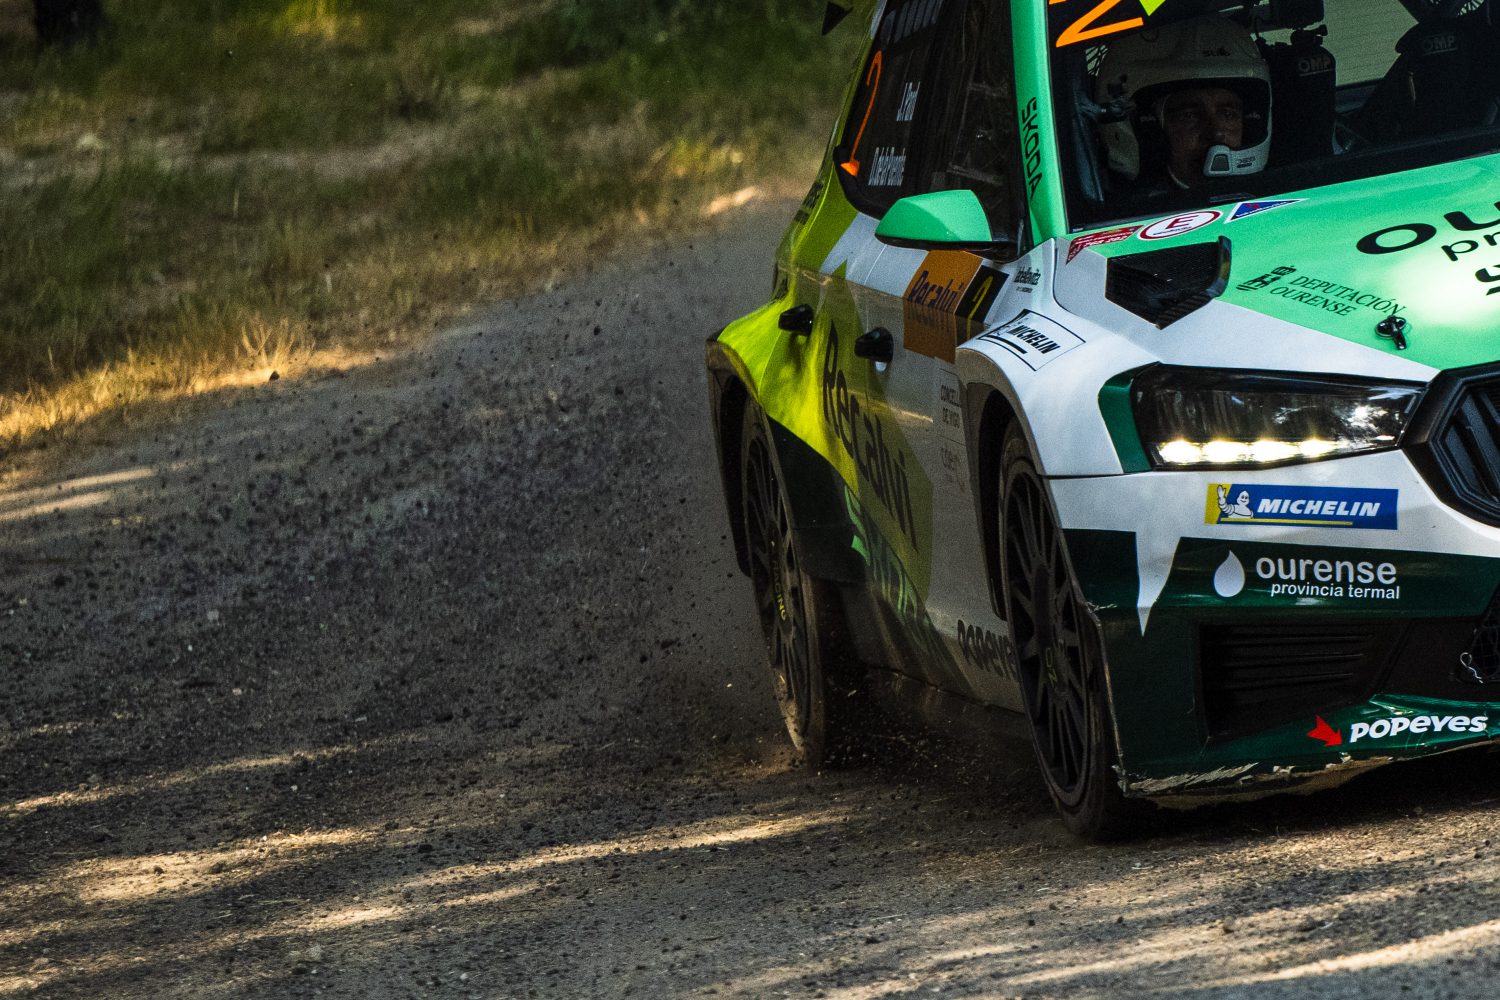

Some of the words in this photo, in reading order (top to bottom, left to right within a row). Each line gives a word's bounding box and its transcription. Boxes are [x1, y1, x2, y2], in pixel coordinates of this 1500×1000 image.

[1421, 35, 1456, 52] OMP
[1298, 56, 1332, 74] OMP
[1021, 97, 1043, 199] SKODA
[907, 269, 965, 332] Recalvi
[1270, 286, 1357, 316] OURENSE
[1289, 274, 1406, 316] DEPUTACIÓN
[1007, 323, 1061, 354] MICHELIN
[823, 320, 919, 553] Recalvi
[1257, 498, 1380, 517] MICHELIN
[1255, 557, 1397, 584] ourense
[1271, 581, 1343, 597] provincia
[1348, 584, 1400, 599] termal
